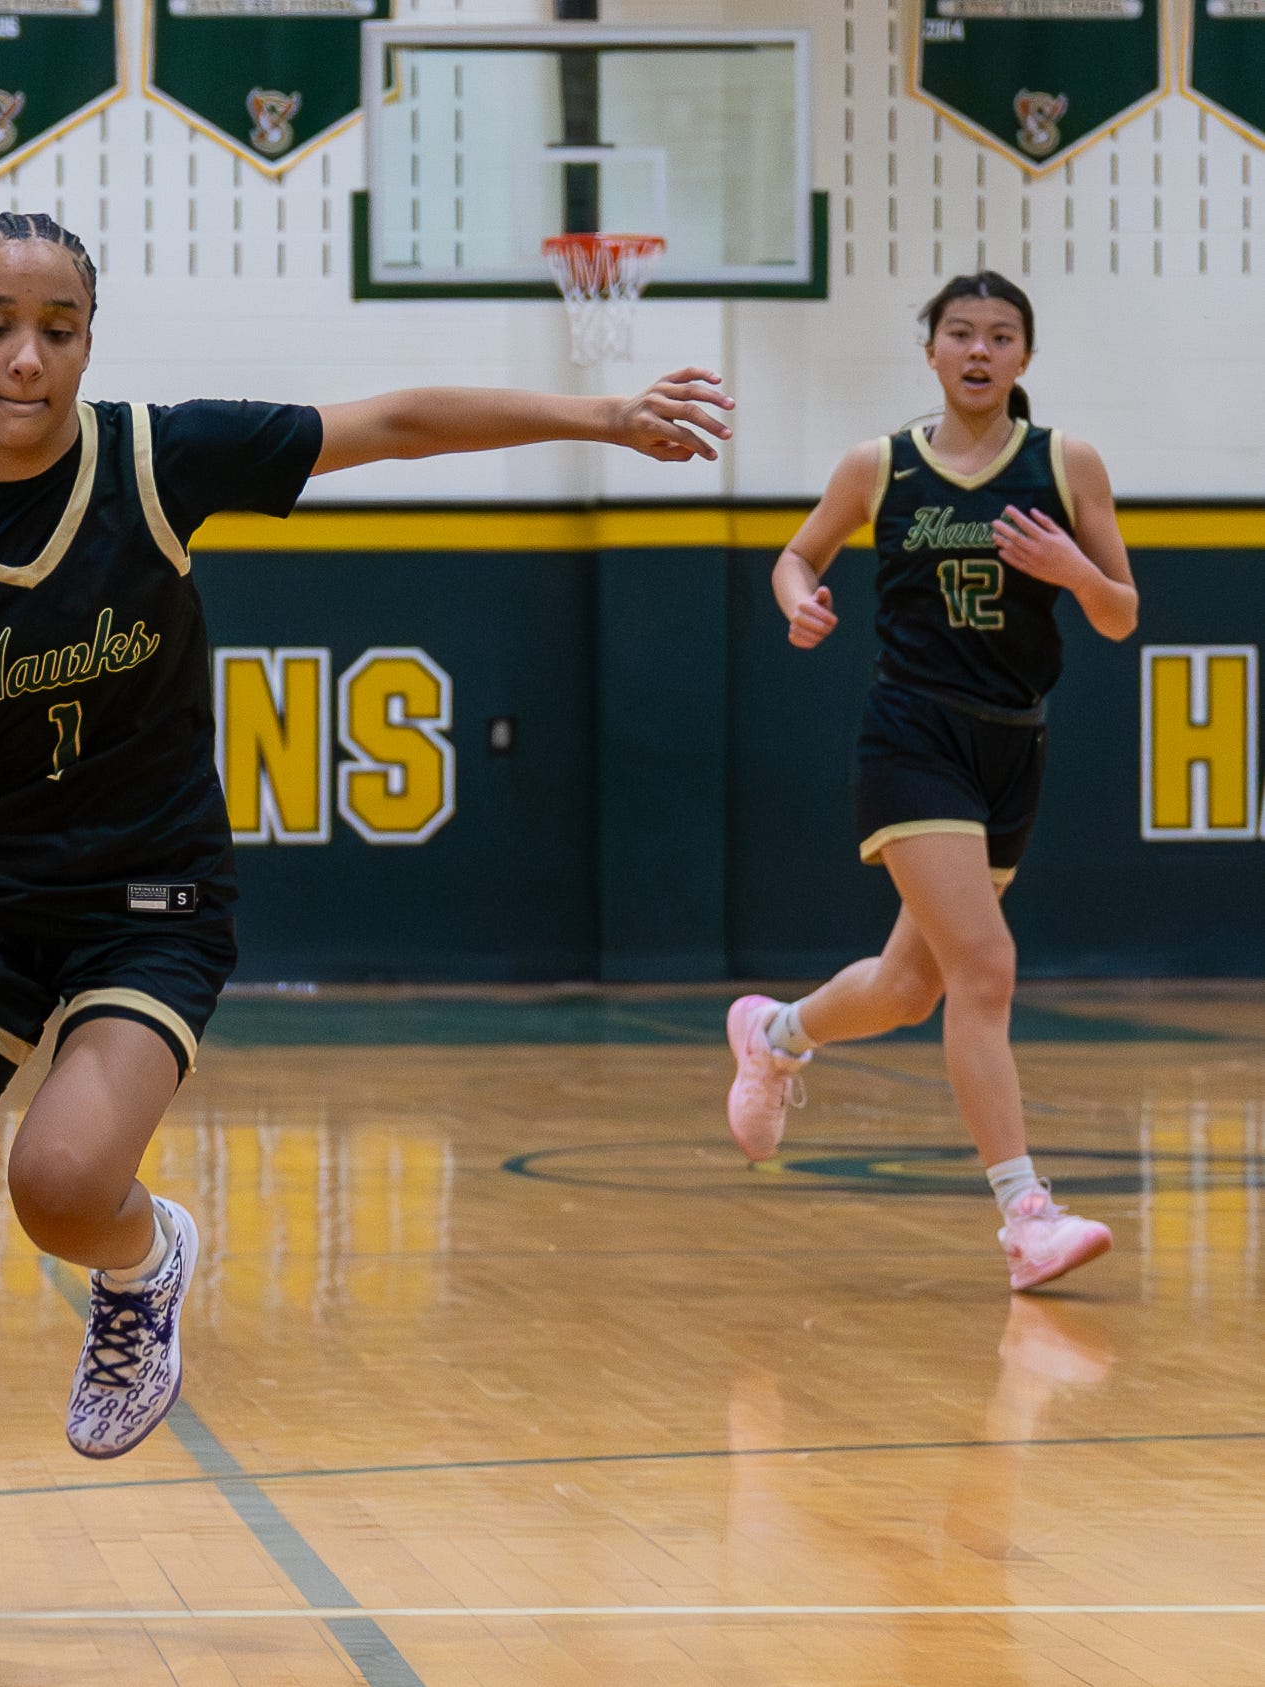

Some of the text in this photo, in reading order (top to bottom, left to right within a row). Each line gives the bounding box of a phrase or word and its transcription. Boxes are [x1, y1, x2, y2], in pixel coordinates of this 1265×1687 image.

[937, 558, 1005, 630] 12
[46, 699, 83, 782] 1
[177, 892, 188, 906] S
